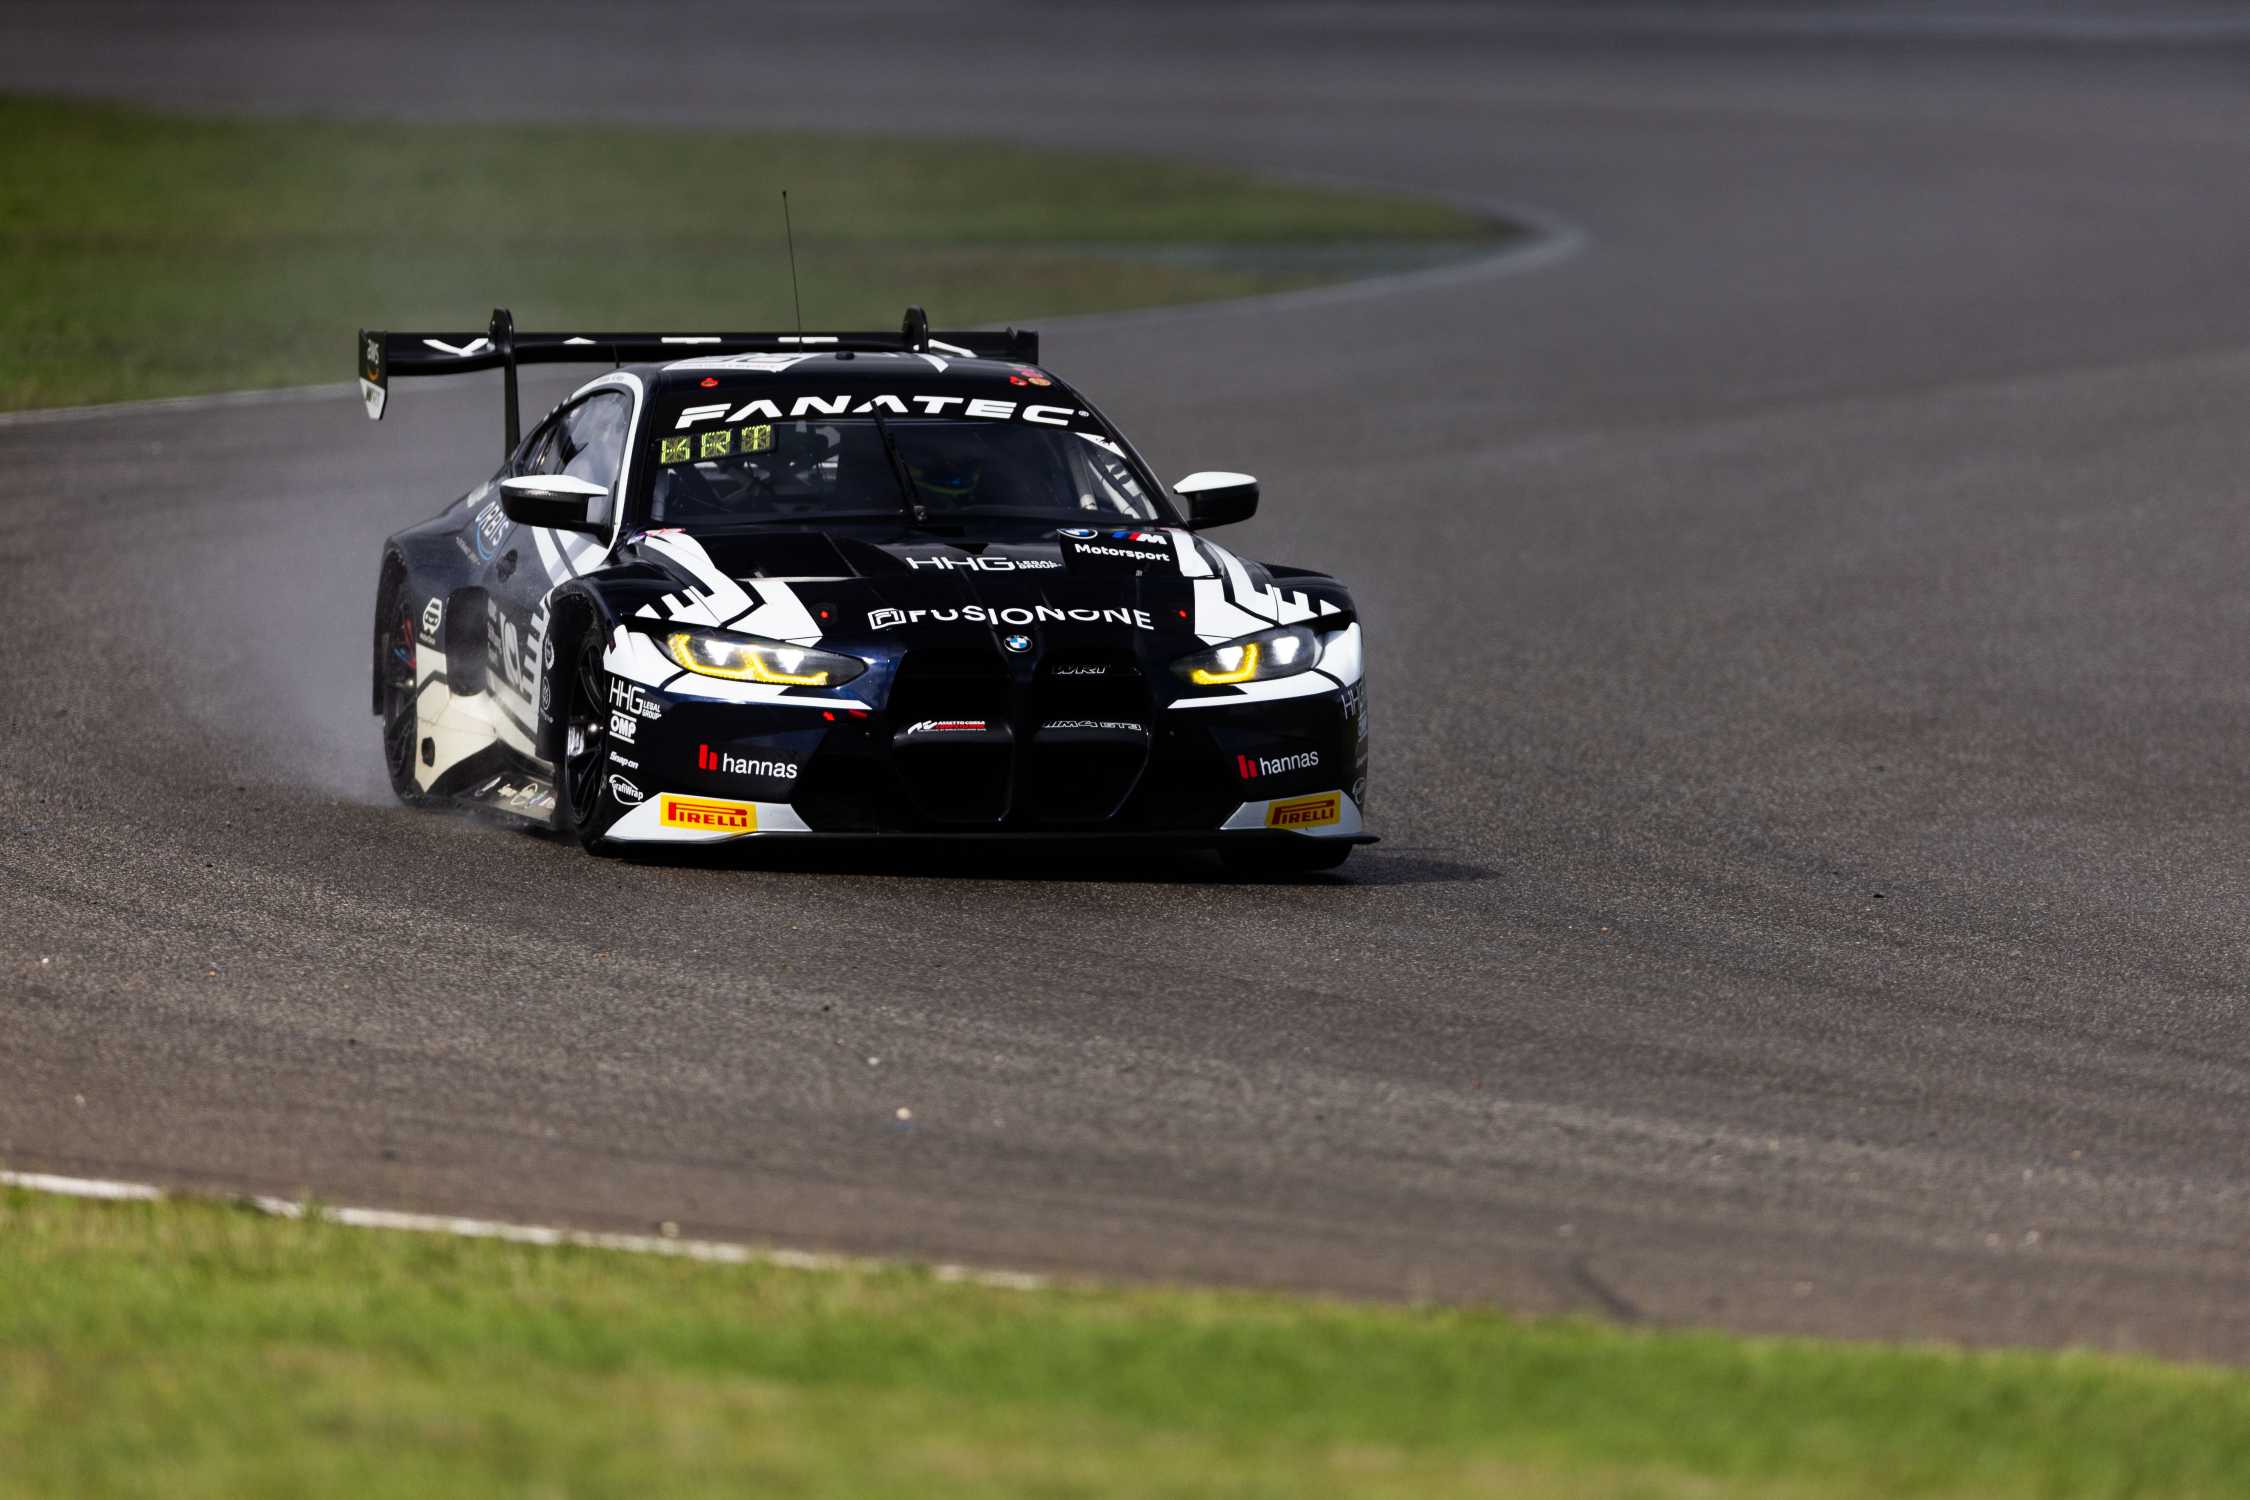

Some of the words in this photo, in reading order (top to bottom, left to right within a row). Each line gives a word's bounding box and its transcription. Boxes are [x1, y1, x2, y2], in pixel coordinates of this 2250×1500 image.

[905, 556, 1015, 571] HHG
[1074, 543, 1170, 562] Motorsport
[908, 605, 1155, 630] FUSIONONE
[609, 676, 645, 715] HHG
[610, 715, 637, 738] OMP
[609, 751, 639, 769] Snap-on
[722, 752, 798, 779] hannas
[1260, 751, 1319, 776] hannas
[668, 801, 748, 828] PIRELLI
[1271, 799, 1335, 825] PIRELLI
